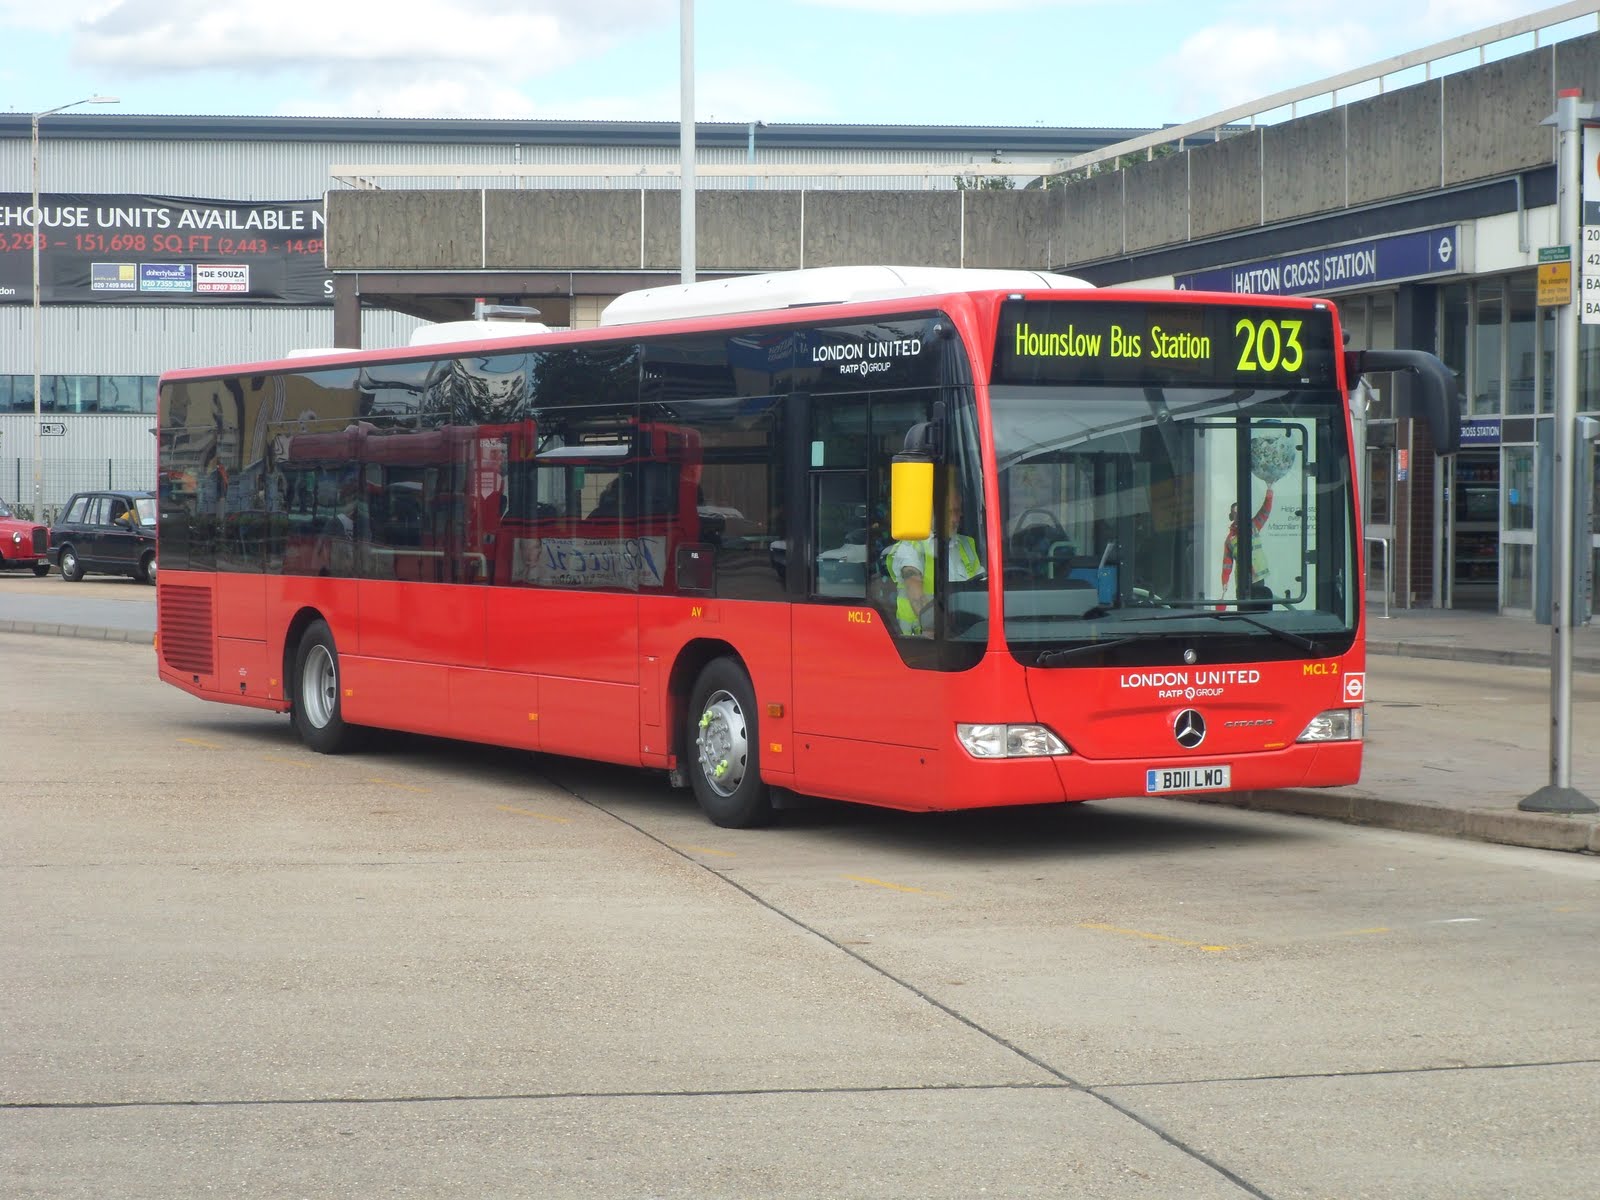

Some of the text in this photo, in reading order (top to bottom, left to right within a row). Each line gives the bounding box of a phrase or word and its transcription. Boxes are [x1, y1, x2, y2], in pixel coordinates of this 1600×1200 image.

[97, 207, 170, 228] UNITS
[177, 209, 304, 230] AVAILABLE
[75, 233, 146, 253] 151,698
[153, 234, 183, 254] SQ
[188, 235, 213, 253] FT
[218, 237, 267, 256] (2,443
[1235, 250, 1375, 294] HATTON CROSS STATION
[813, 343, 863, 361] LONDON
[868, 339, 921, 358] UNITED
[1016, 319, 1303, 372] Hounslow Bus Station 203
[840, 362, 891, 374] RATP GROUP
[691, 607, 702, 617] AV
[848, 611, 866, 623] MCL
[1303, 663, 1338, 675] MCL 2
[1121, 670, 1260, 688] LONDON UNITED
[1158, 688, 1224, 698] RATP GROUP
[1163, 769, 1222, 789] BD11 LWO
